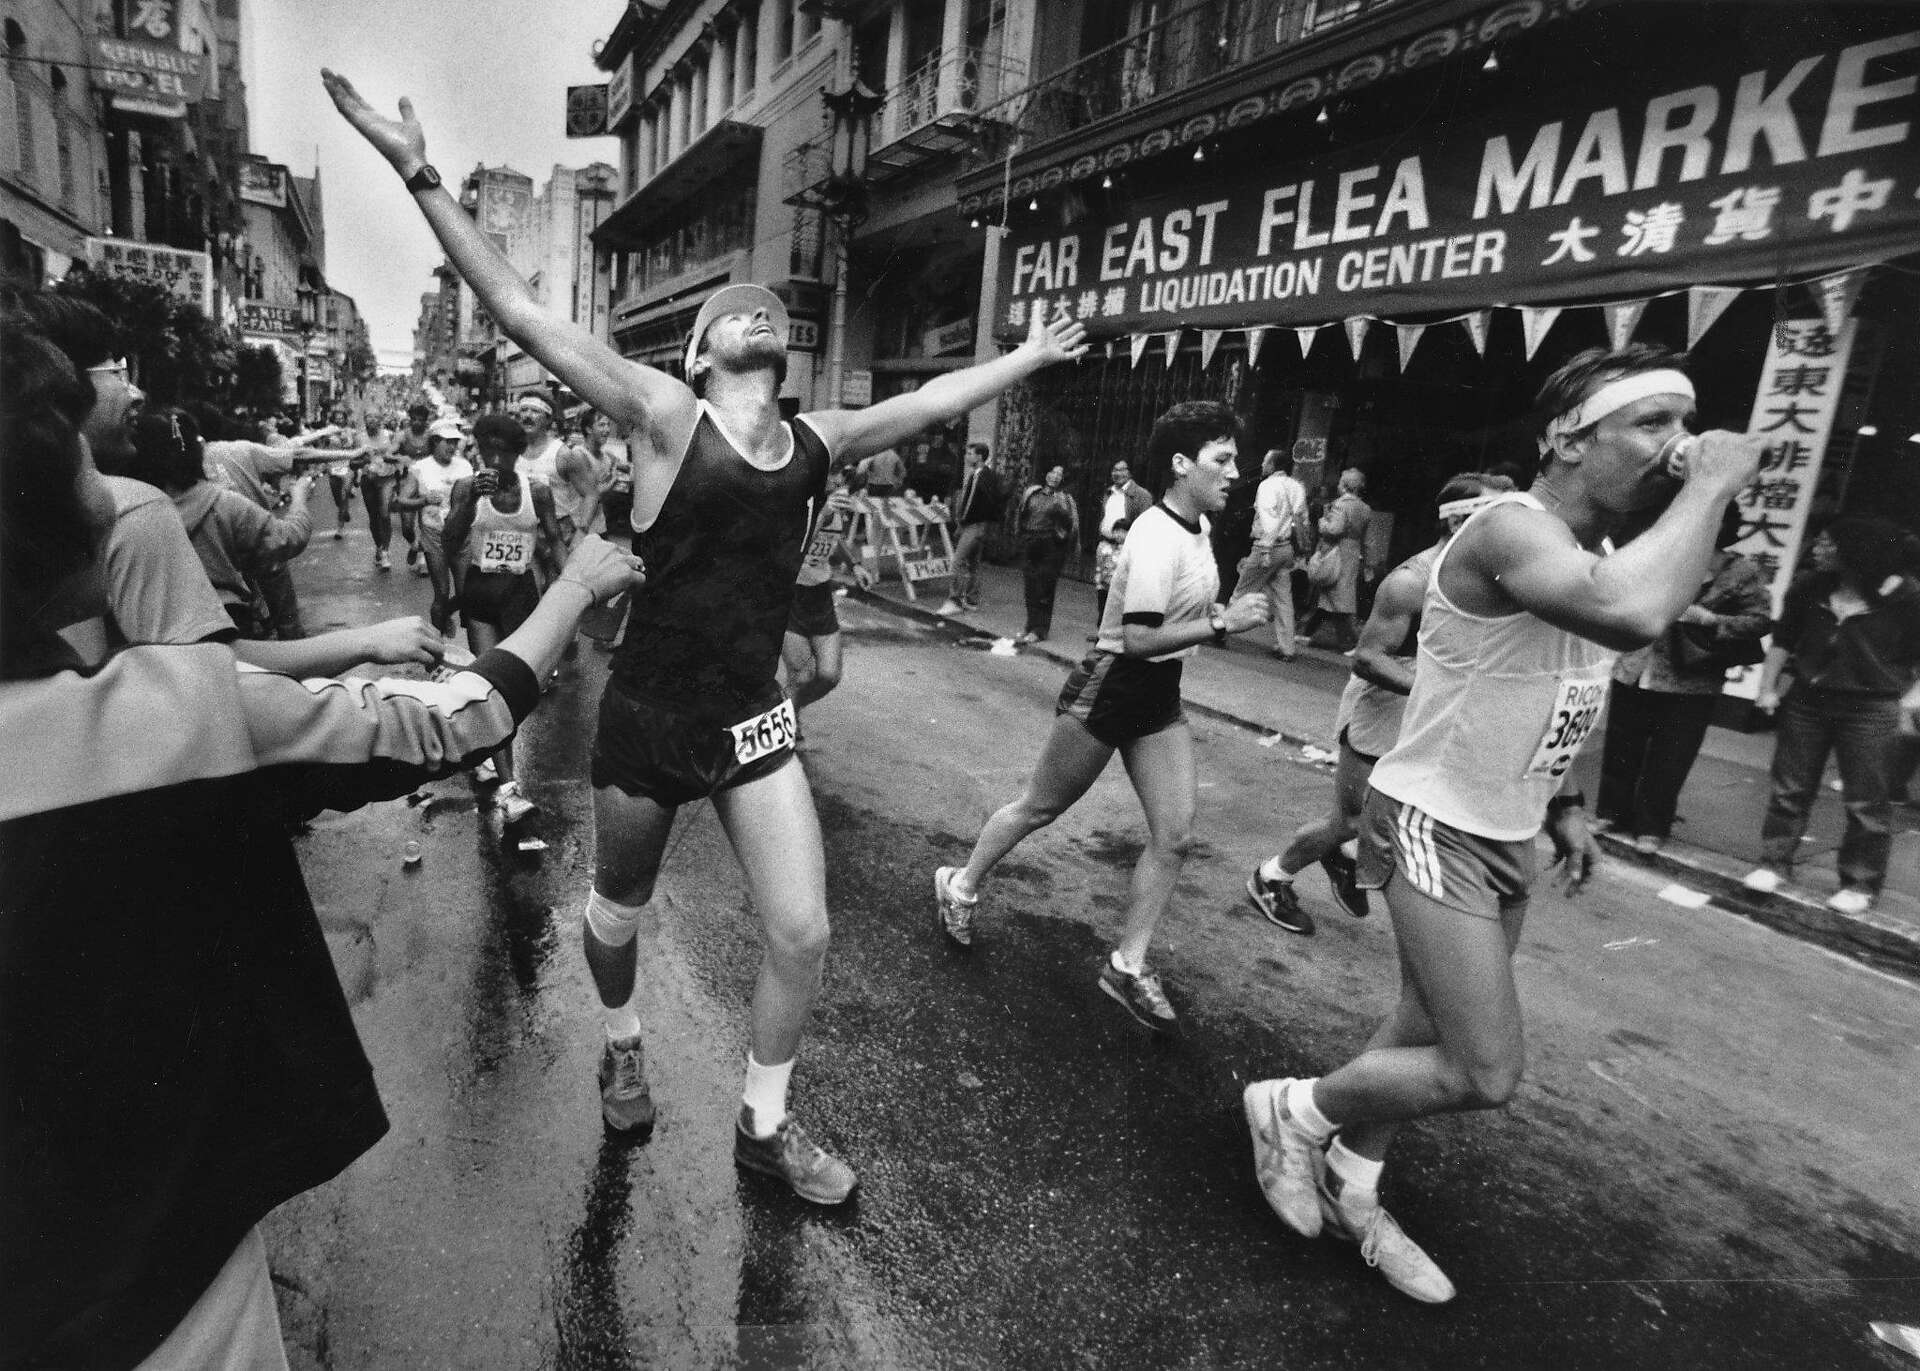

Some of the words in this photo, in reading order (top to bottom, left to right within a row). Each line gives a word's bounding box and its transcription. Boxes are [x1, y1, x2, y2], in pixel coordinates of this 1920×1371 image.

[100, 40, 200, 75] REPUBLIC
[1012, 235, 1080, 296] FAR
[1100, 199, 1229, 282] EAST
[1257, 155, 1430, 257] FLEA
[1472, 30, 1920, 220] MARKE
[1541, 168, 1920, 267] 大清貨中
[1140, 258, 1323, 313] LIQUIDATION
[1337, 229, 1508, 292] CENTER
[486, 542, 523, 561] 2525
[740, 706, 794, 758] 5656
